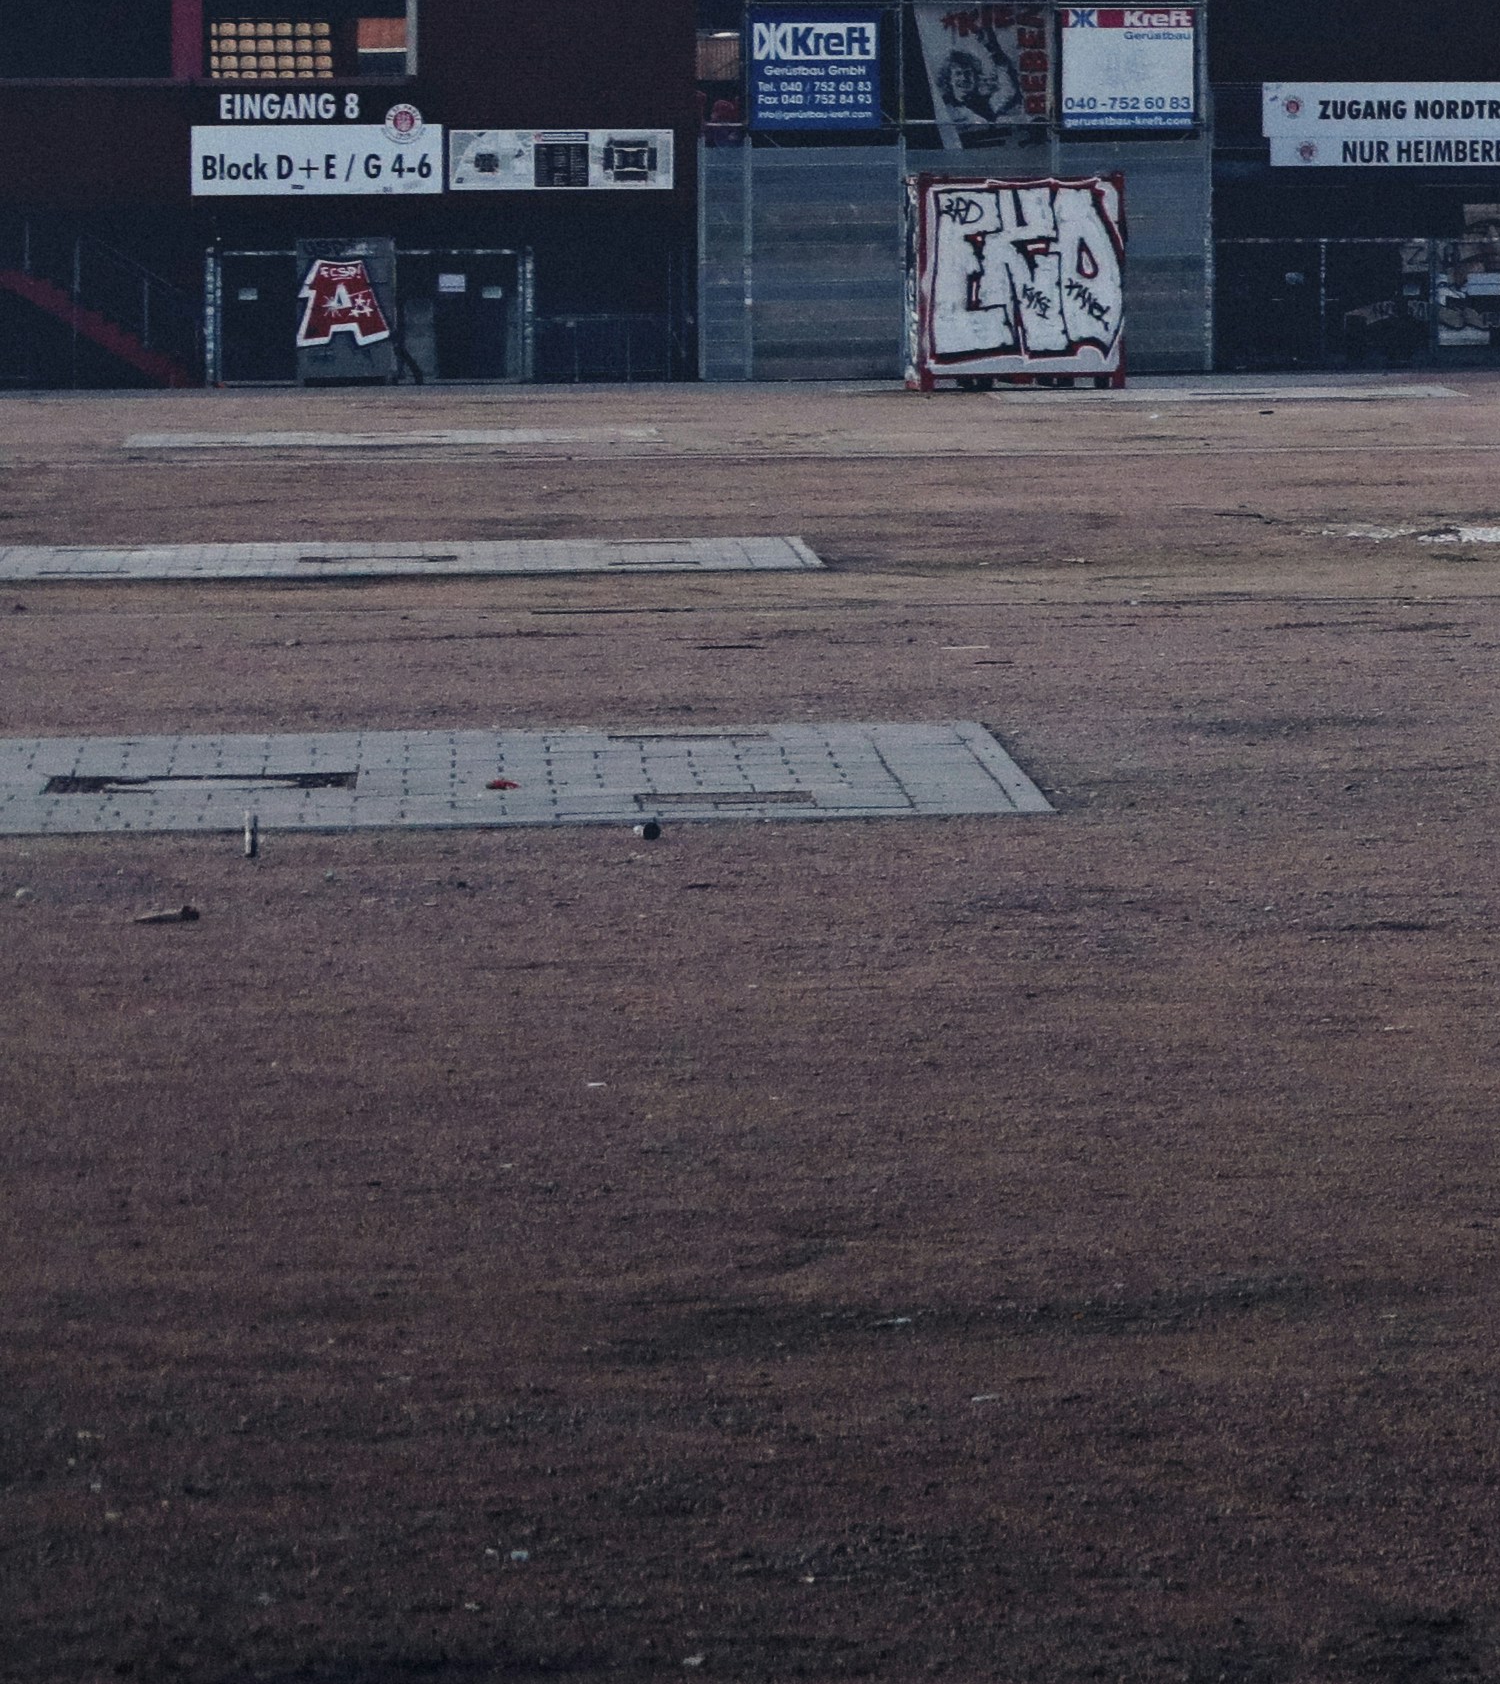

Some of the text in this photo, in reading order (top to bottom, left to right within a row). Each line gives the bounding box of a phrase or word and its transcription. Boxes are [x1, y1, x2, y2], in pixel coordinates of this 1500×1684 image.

[1123, 10, 1193, 27] Kreft
[791, 26, 871, 56] Kreft
[1123, 30, 1191, 40] Gerüstbau
[763, 64, 867, 76] Gerüstbau GmbH
[757, 81, 776, 92] Tel.
[780, 81, 803, 92] 040
[813, 81, 836, 92] 752
[839, 81, 855, 92] 60
[857, 81, 872, 92] 83
[219, 93, 361, 120] EINGANG 8
[757, 94, 779, 104] Fax
[781, 94, 804, 104] 040
[814, 94, 837, 105] 752
[839, 94, 855, 104] 84
[857, 94, 872, 104] 93
[1144, 97, 1165, 110] 60
[1169, 97, 1191, 110] 83
[1318, 100, 1407, 120] ZUGANG
[1342, 141, 1389, 163] NUR
[202, 154, 269, 180] Block
[344, 154, 356, 182] /
[364, 154, 382, 179] G
[391, 154, 432, 179] 4-6
